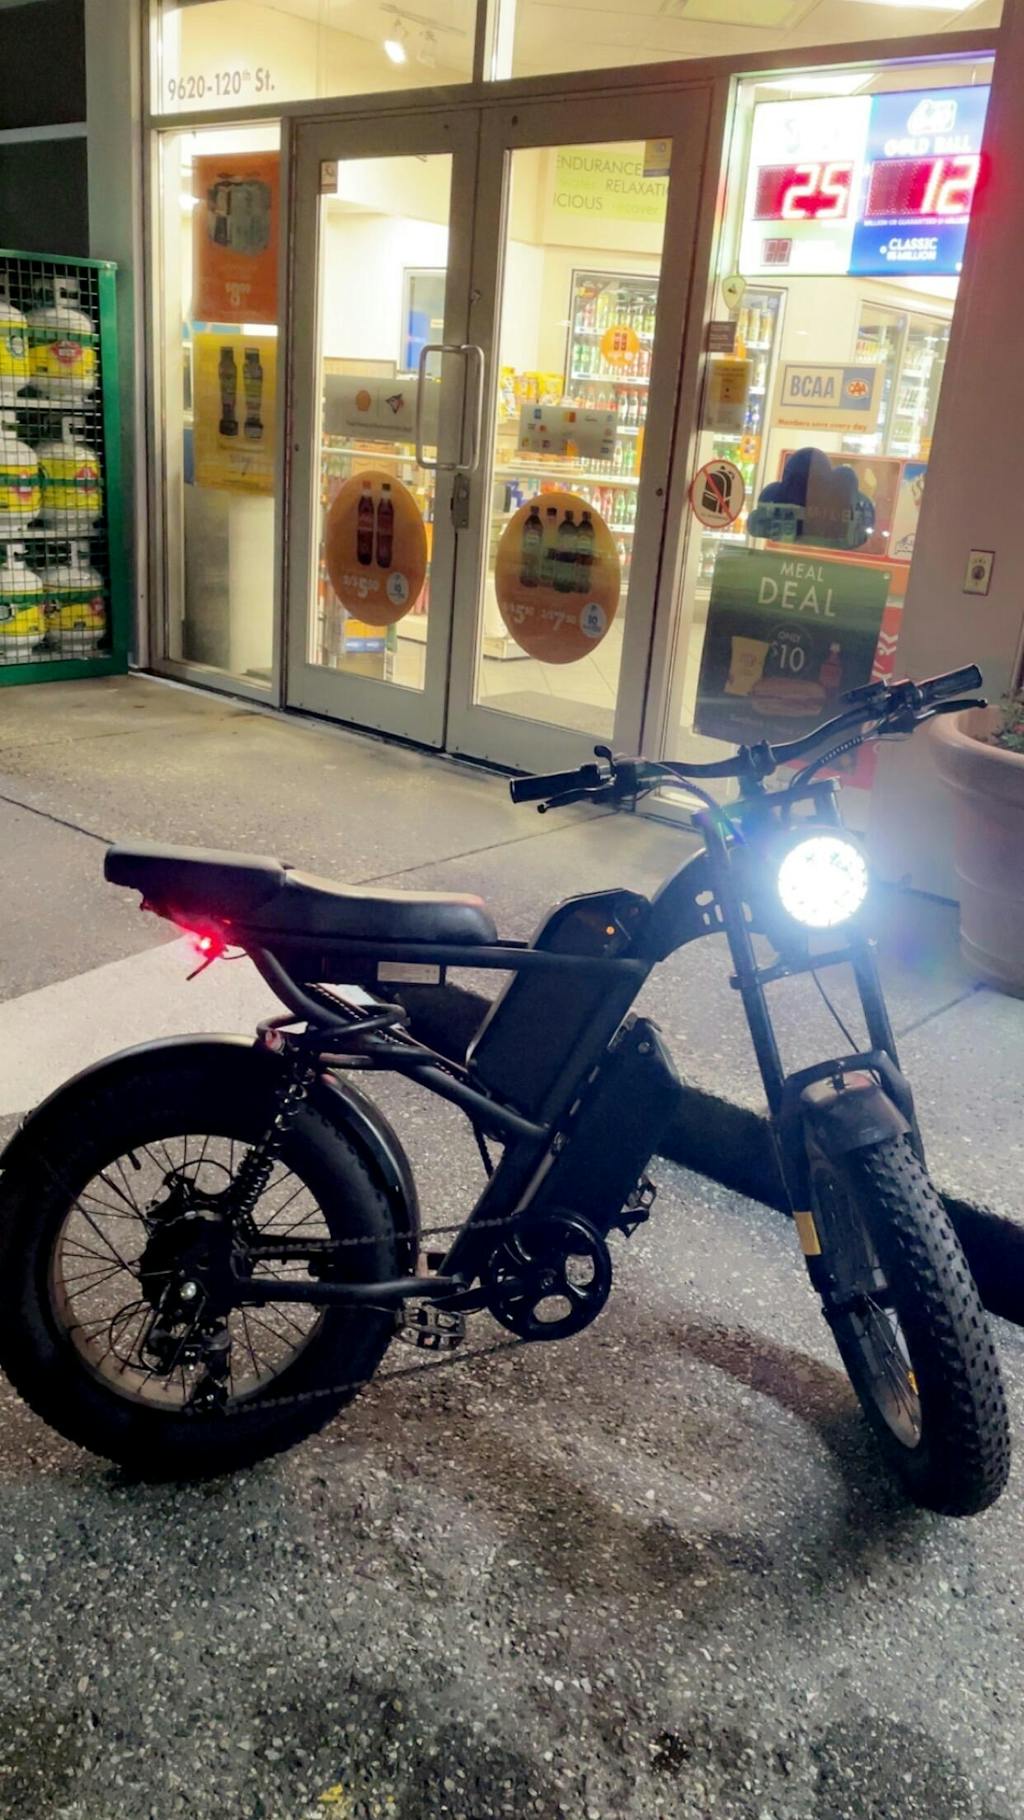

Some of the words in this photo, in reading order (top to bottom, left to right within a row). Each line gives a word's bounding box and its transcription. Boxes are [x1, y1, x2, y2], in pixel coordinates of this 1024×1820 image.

[255, 67, 275, 92] St.
[782, 163, 850, 219] 25
[921, 155, 981, 214] 12
[887, 237, 938, 251] CLASSIC
[789, 375, 835, 399] BCAA
[780, 562, 824, 582] MEAL
[757, 577, 836, 617] DEAL
[771, 641, 805, 672] $10
